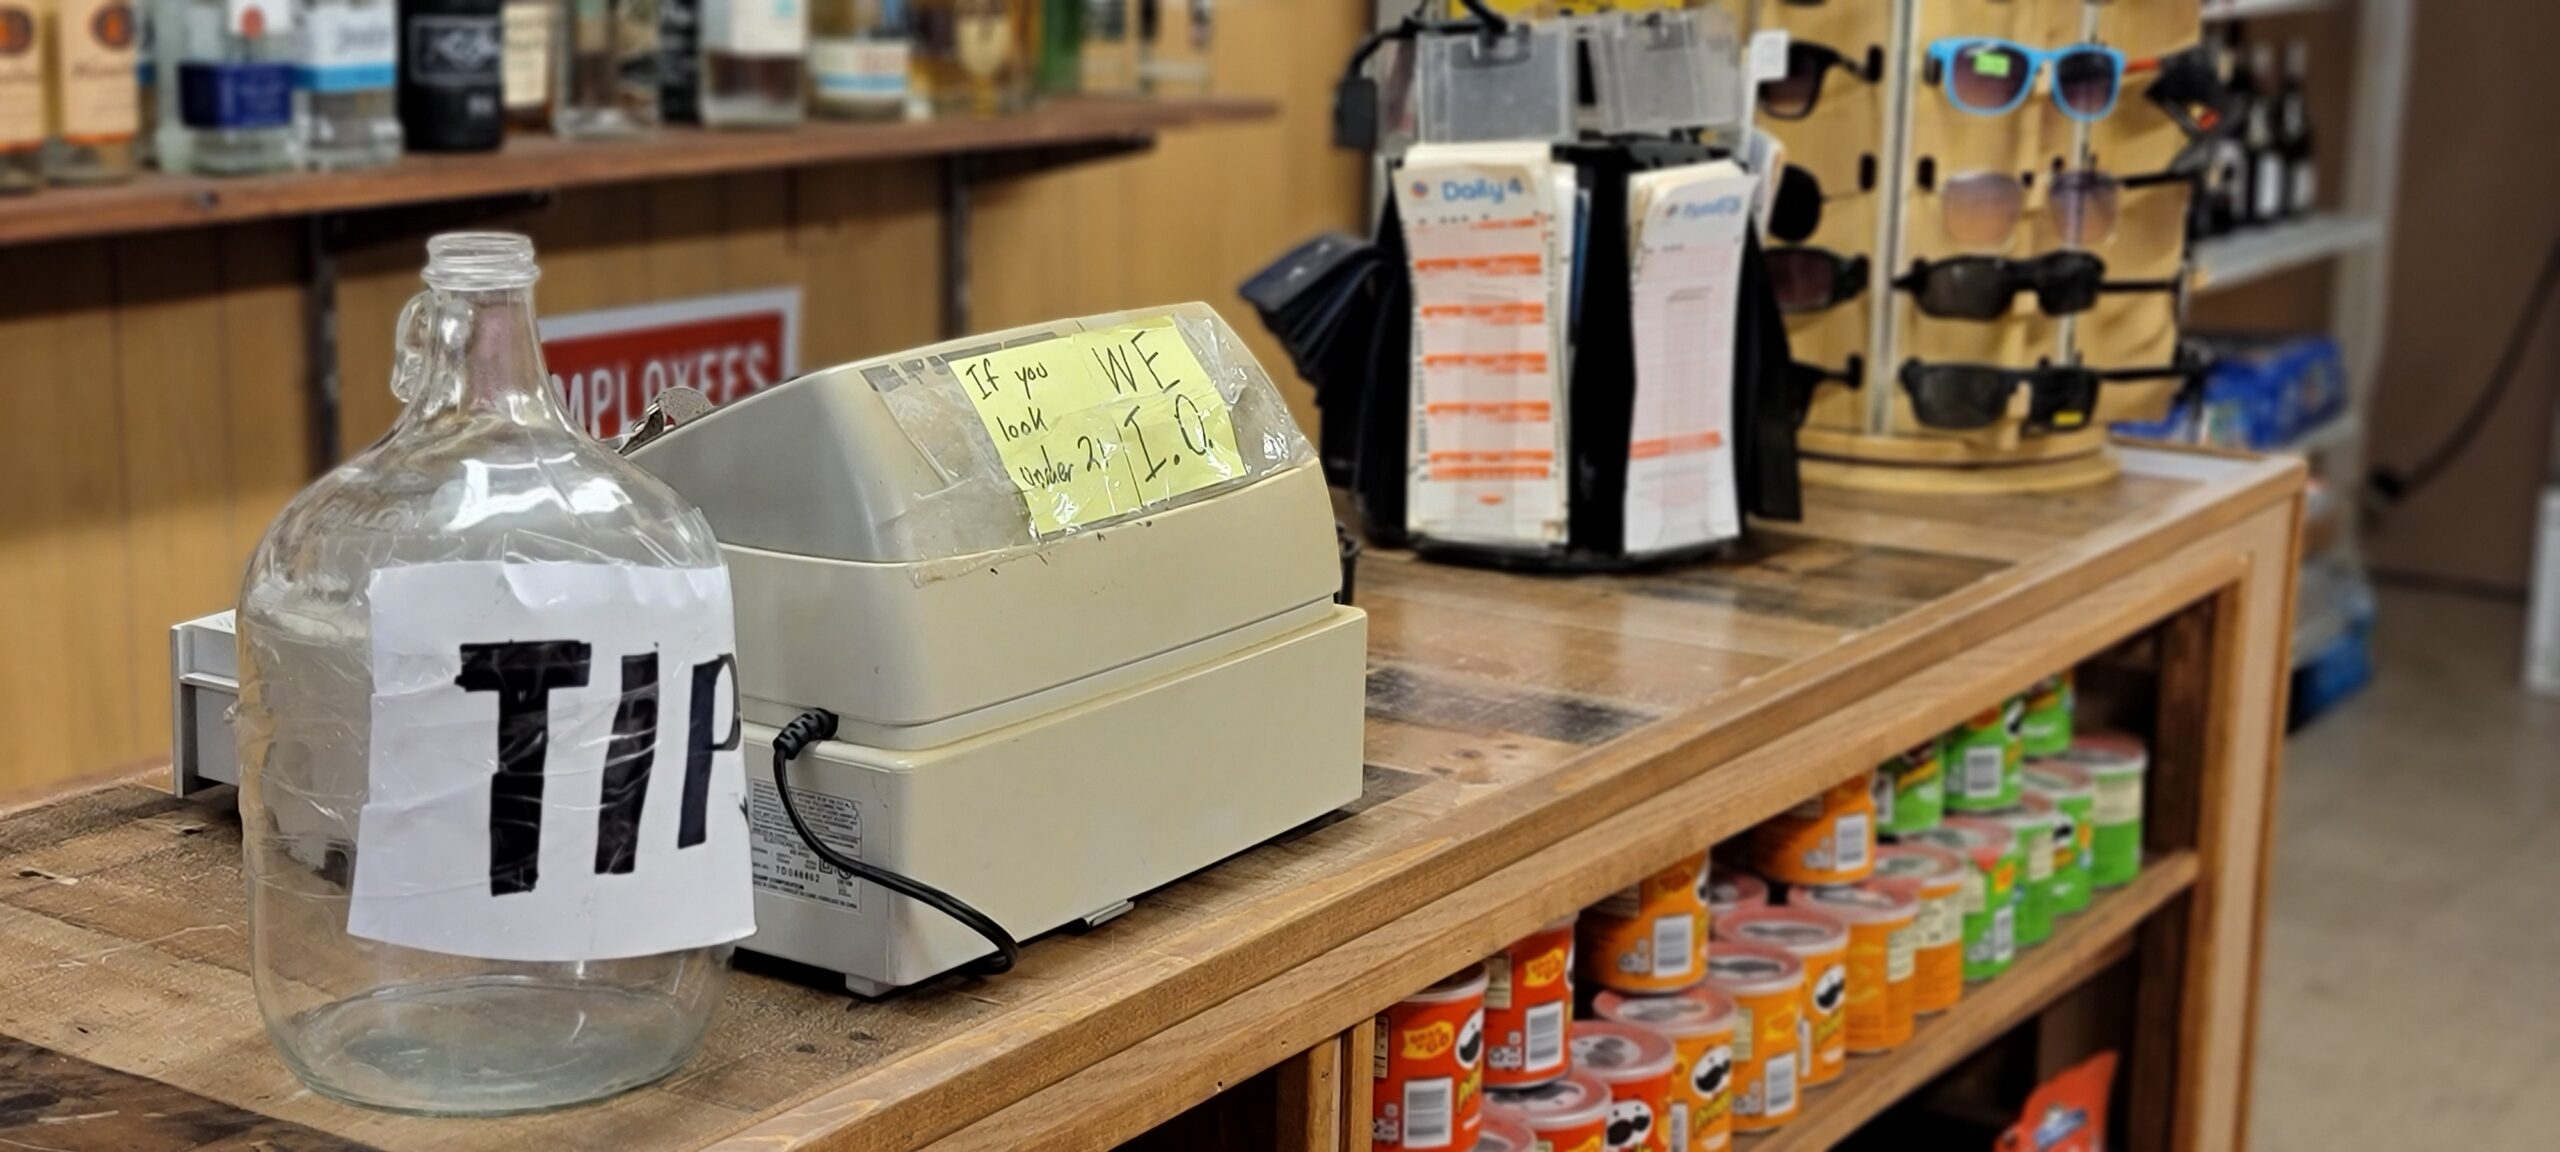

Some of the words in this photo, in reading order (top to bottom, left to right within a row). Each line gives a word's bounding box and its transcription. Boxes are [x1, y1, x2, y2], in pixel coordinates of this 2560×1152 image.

[1441, 178, 1504, 203] Daily
[1508, 177, 1524, 194] 4
[966, 358, 1000, 400] If
[1015, 362, 1049, 399] you
[1091, 330, 1180, 395] WE
[550, 344, 770, 440] MPLOYEES
[996, 406, 1049, 442] look
[1077, 436, 1110, 472] 21
[454, 639, 747, 897] TIP
